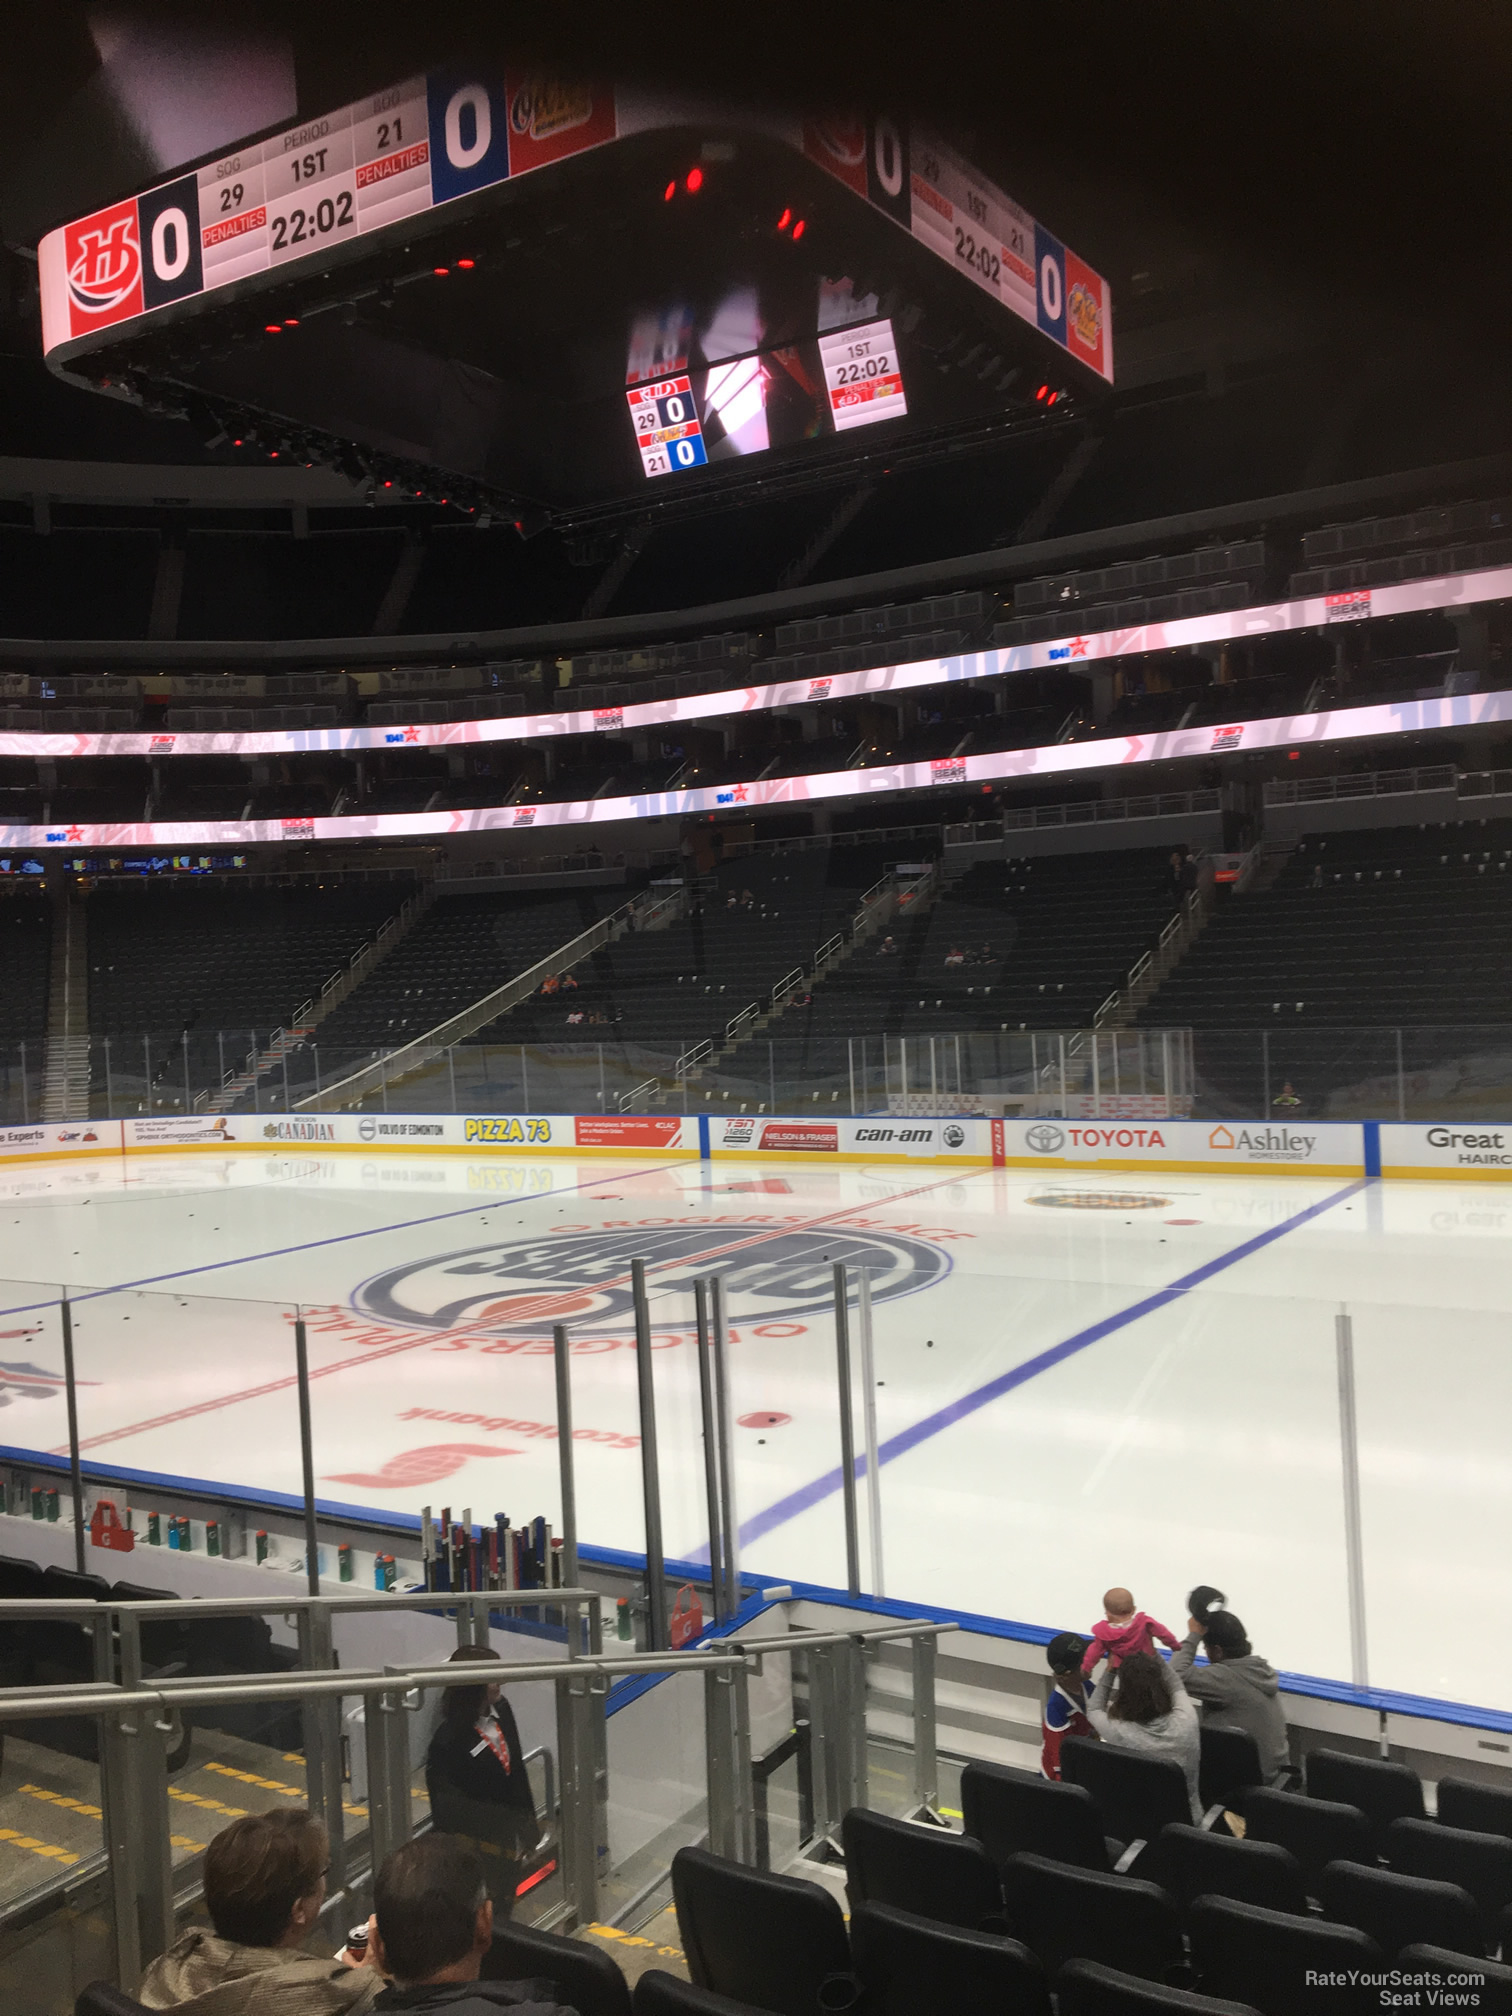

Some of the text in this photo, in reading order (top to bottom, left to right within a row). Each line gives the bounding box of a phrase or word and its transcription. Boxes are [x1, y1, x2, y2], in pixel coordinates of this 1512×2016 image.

[283, 121, 329, 151] PERIOD
[377, 117, 403, 150] 21
[445, 83, 491, 169] 0
[217, 157, 241, 179] SOG
[291, 149, 329, 182] 1ST
[357, 147, 428, 187] PENALTIES
[220, 183, 244, 212] 29
[203, 211, 266, 246] PENALTIES
[271, 191, 354, 251] 22:02
[151, 207, 190, 281] 0
[955, 226, 1001, 286] 22:02
[1041, 254, 1063, 321] 0
[848, 341, 871, 358] 1ST
[837, 356, 890, 385] 22:02
[638, 413, 655, 430] 29
[666, 397, 685, 423] 0
[648, 456, 666, 472] 21
[676, 440, 695, 466] 0
[278, 1122, 334, 1140] CANADIAN
[378, 1124, 444, 1136] VOLVO OF EDMONTON
[465, 1118, 551, 1142] PIZZA 73
[726, 1119, 755, 1128] TSN
[728, 1128, 752, 1136] 1260
[855, 1128, 932, 1143] can-am
[8, 1130, 45, 1144] Experts
[807, 1134, 837, 1142] FRASER
[1068, 1129, 1166, 1148] TOYOTA
[1237, 1128, 1317, 1157] Ashley
[1427, 1127, 1505, 1149] Great
[1248, 1152, 1304, 1160] HOMESTORE
[602, 1215, 978, 1243] ROGERS PLACE
[102, 1532, 111, 1546] G
[683, 1620, 692, 1637] G
